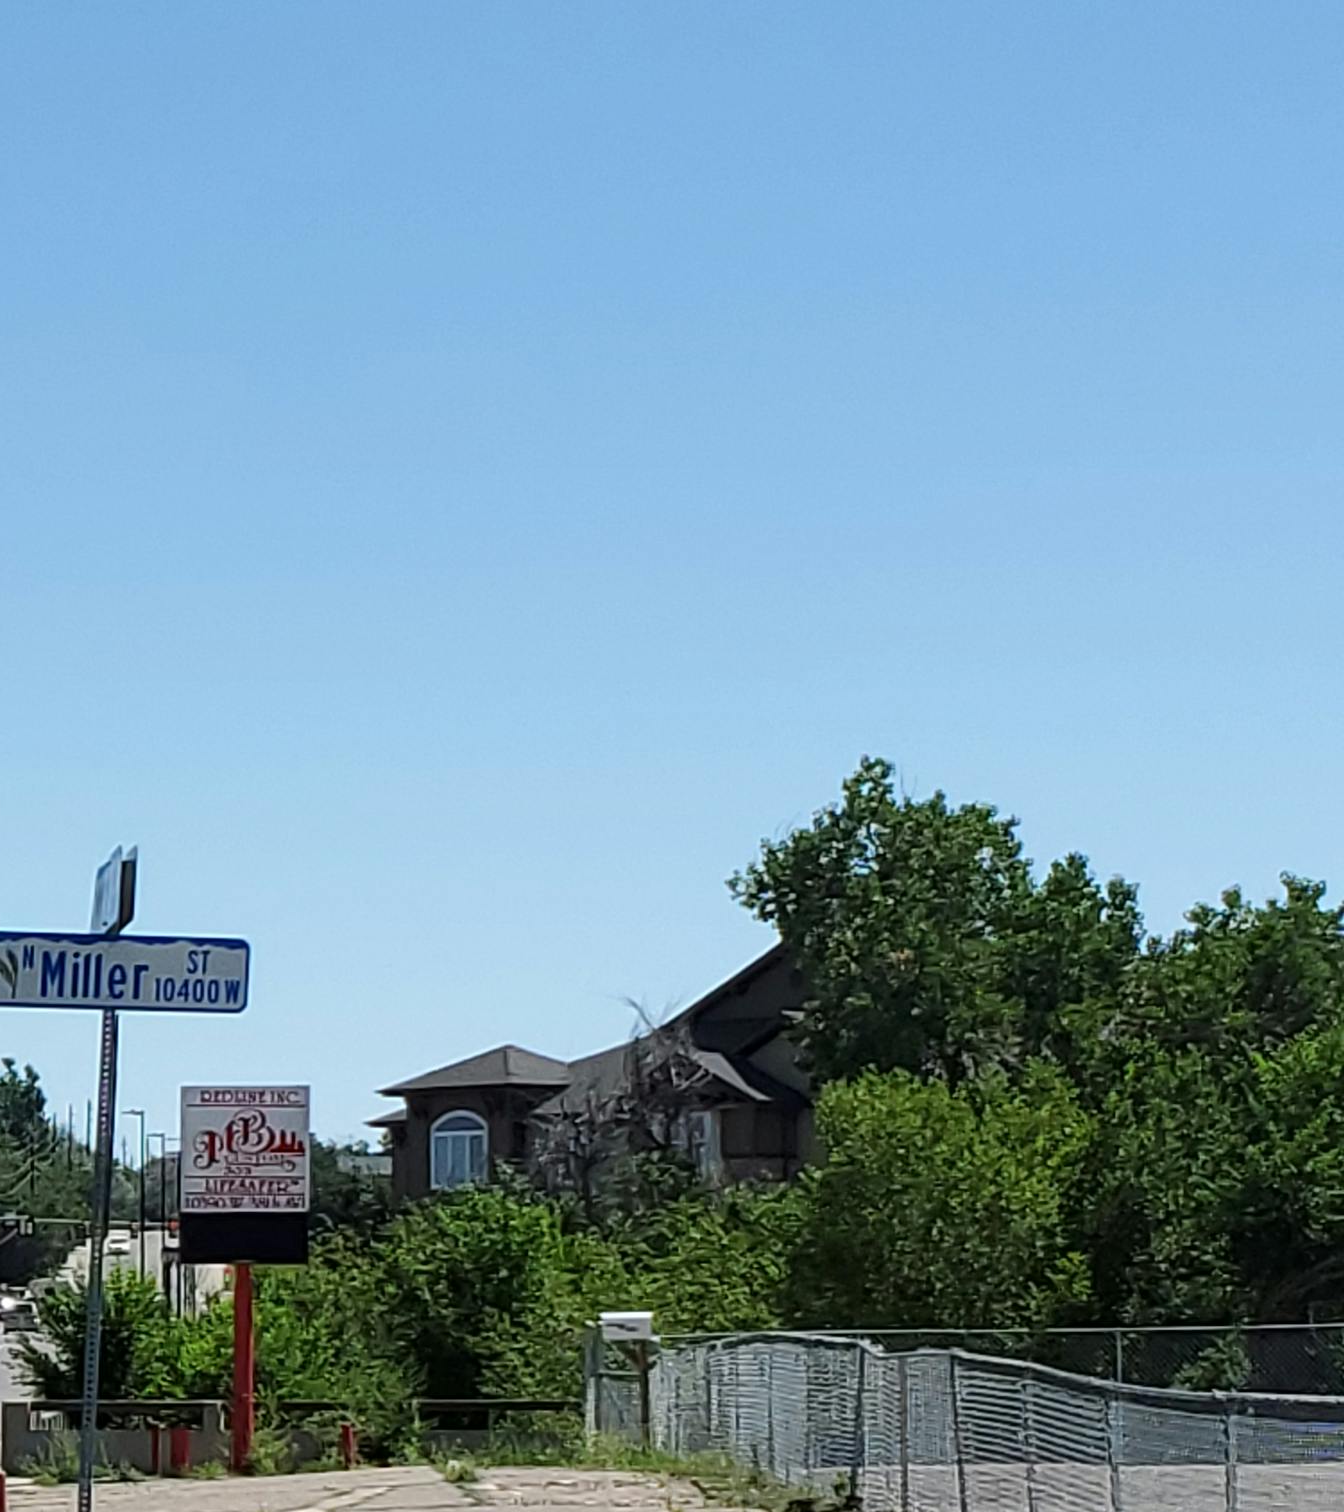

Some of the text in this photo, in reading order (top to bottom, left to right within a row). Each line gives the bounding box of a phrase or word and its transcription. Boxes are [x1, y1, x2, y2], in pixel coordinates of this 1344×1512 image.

[22, 945, 211, 1000] N Miller ST
[154, 977, 240, 1004] 10400 W
